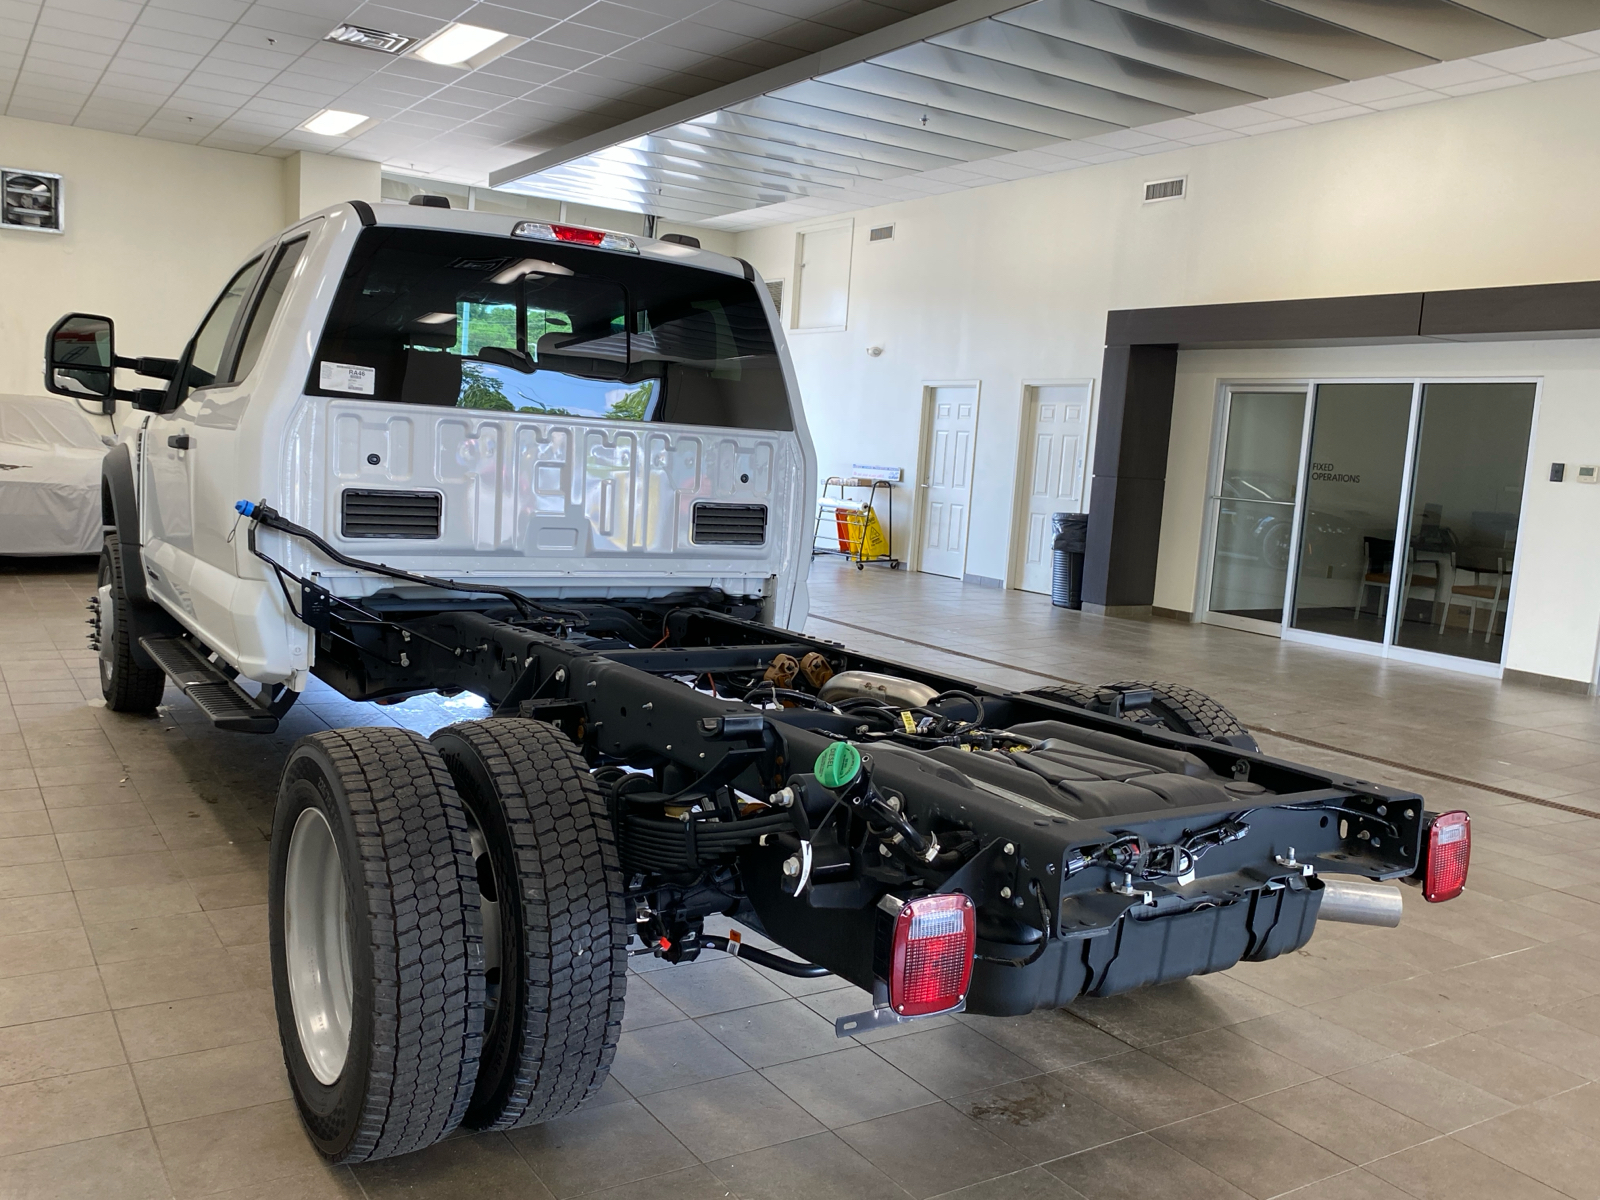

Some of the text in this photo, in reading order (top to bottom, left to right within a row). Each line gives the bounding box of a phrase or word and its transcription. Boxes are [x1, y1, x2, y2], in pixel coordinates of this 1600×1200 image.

[348, 369, 366, 377] RA46
[1312, 462, 1334, 472] FIXED
[1311, 472, 1361, 484] OPERATIONS
[827, 747, 837, 769] DIESEL
